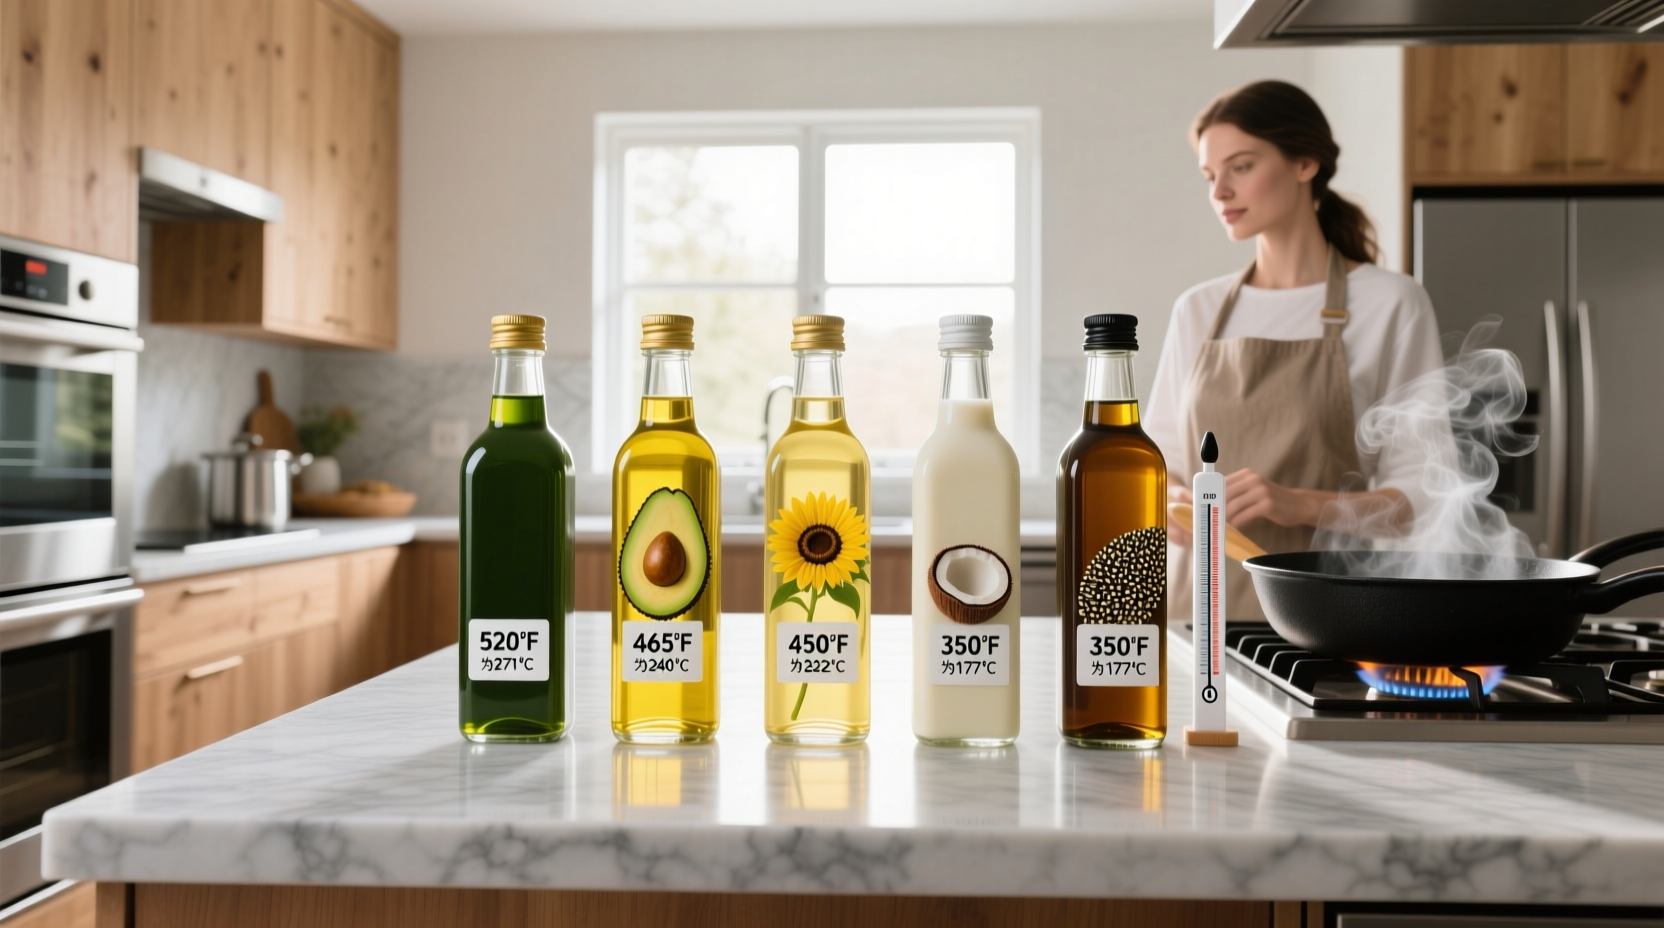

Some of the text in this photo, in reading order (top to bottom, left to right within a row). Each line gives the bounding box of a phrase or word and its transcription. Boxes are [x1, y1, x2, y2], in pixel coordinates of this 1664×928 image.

[481, 631, 539, 651] 520°F
[633, 633, 692, 653] 465°F
[789, 634, 849, 654] 450°F
[942, 635, 1000, 655] 350°F
[1090, 636, 1149, 656] 350°F
